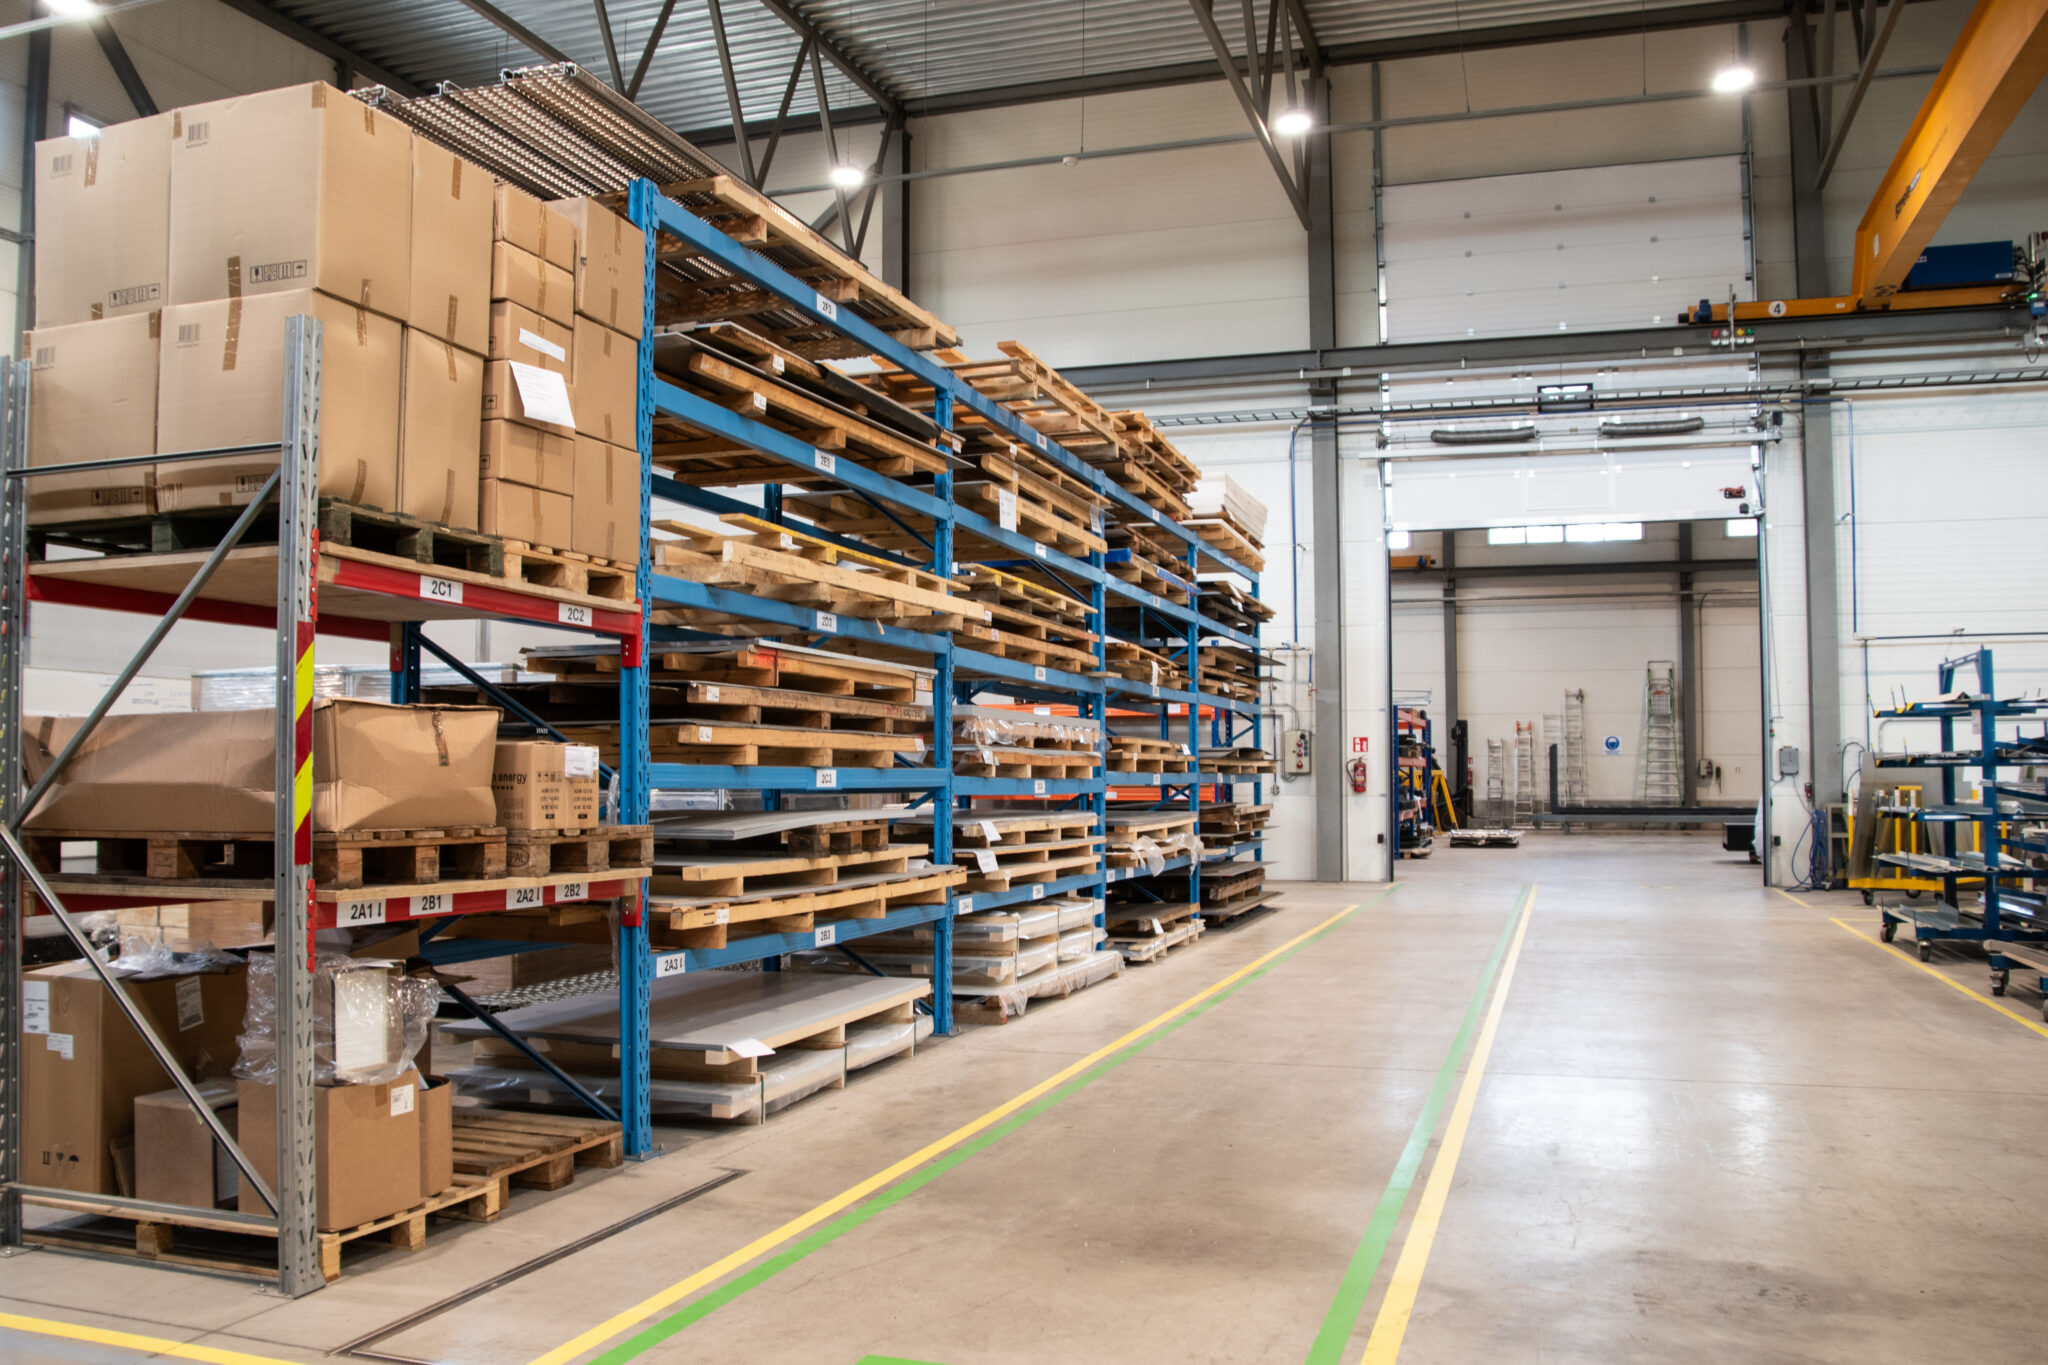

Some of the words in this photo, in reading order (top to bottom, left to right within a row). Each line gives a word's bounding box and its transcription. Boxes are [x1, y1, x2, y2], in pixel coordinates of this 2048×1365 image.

[1773, 303, 1781, 315] 4
[431, 580, 452, 597] 2C1
[567, 607, 585, 622] 2C2
[499, 773, 527, 785] energy
[821, 774, 832, 784] 2C3
[516, 888, 534, 903] 2A2
[564, 884, 581, 897] 2B2
[421, 896, 442, 911] 2B1
[351, 904, 373, 920] 2A1
[820, 930, 831, 942] 2B3
[664, 958, 678, 972] 2A3
